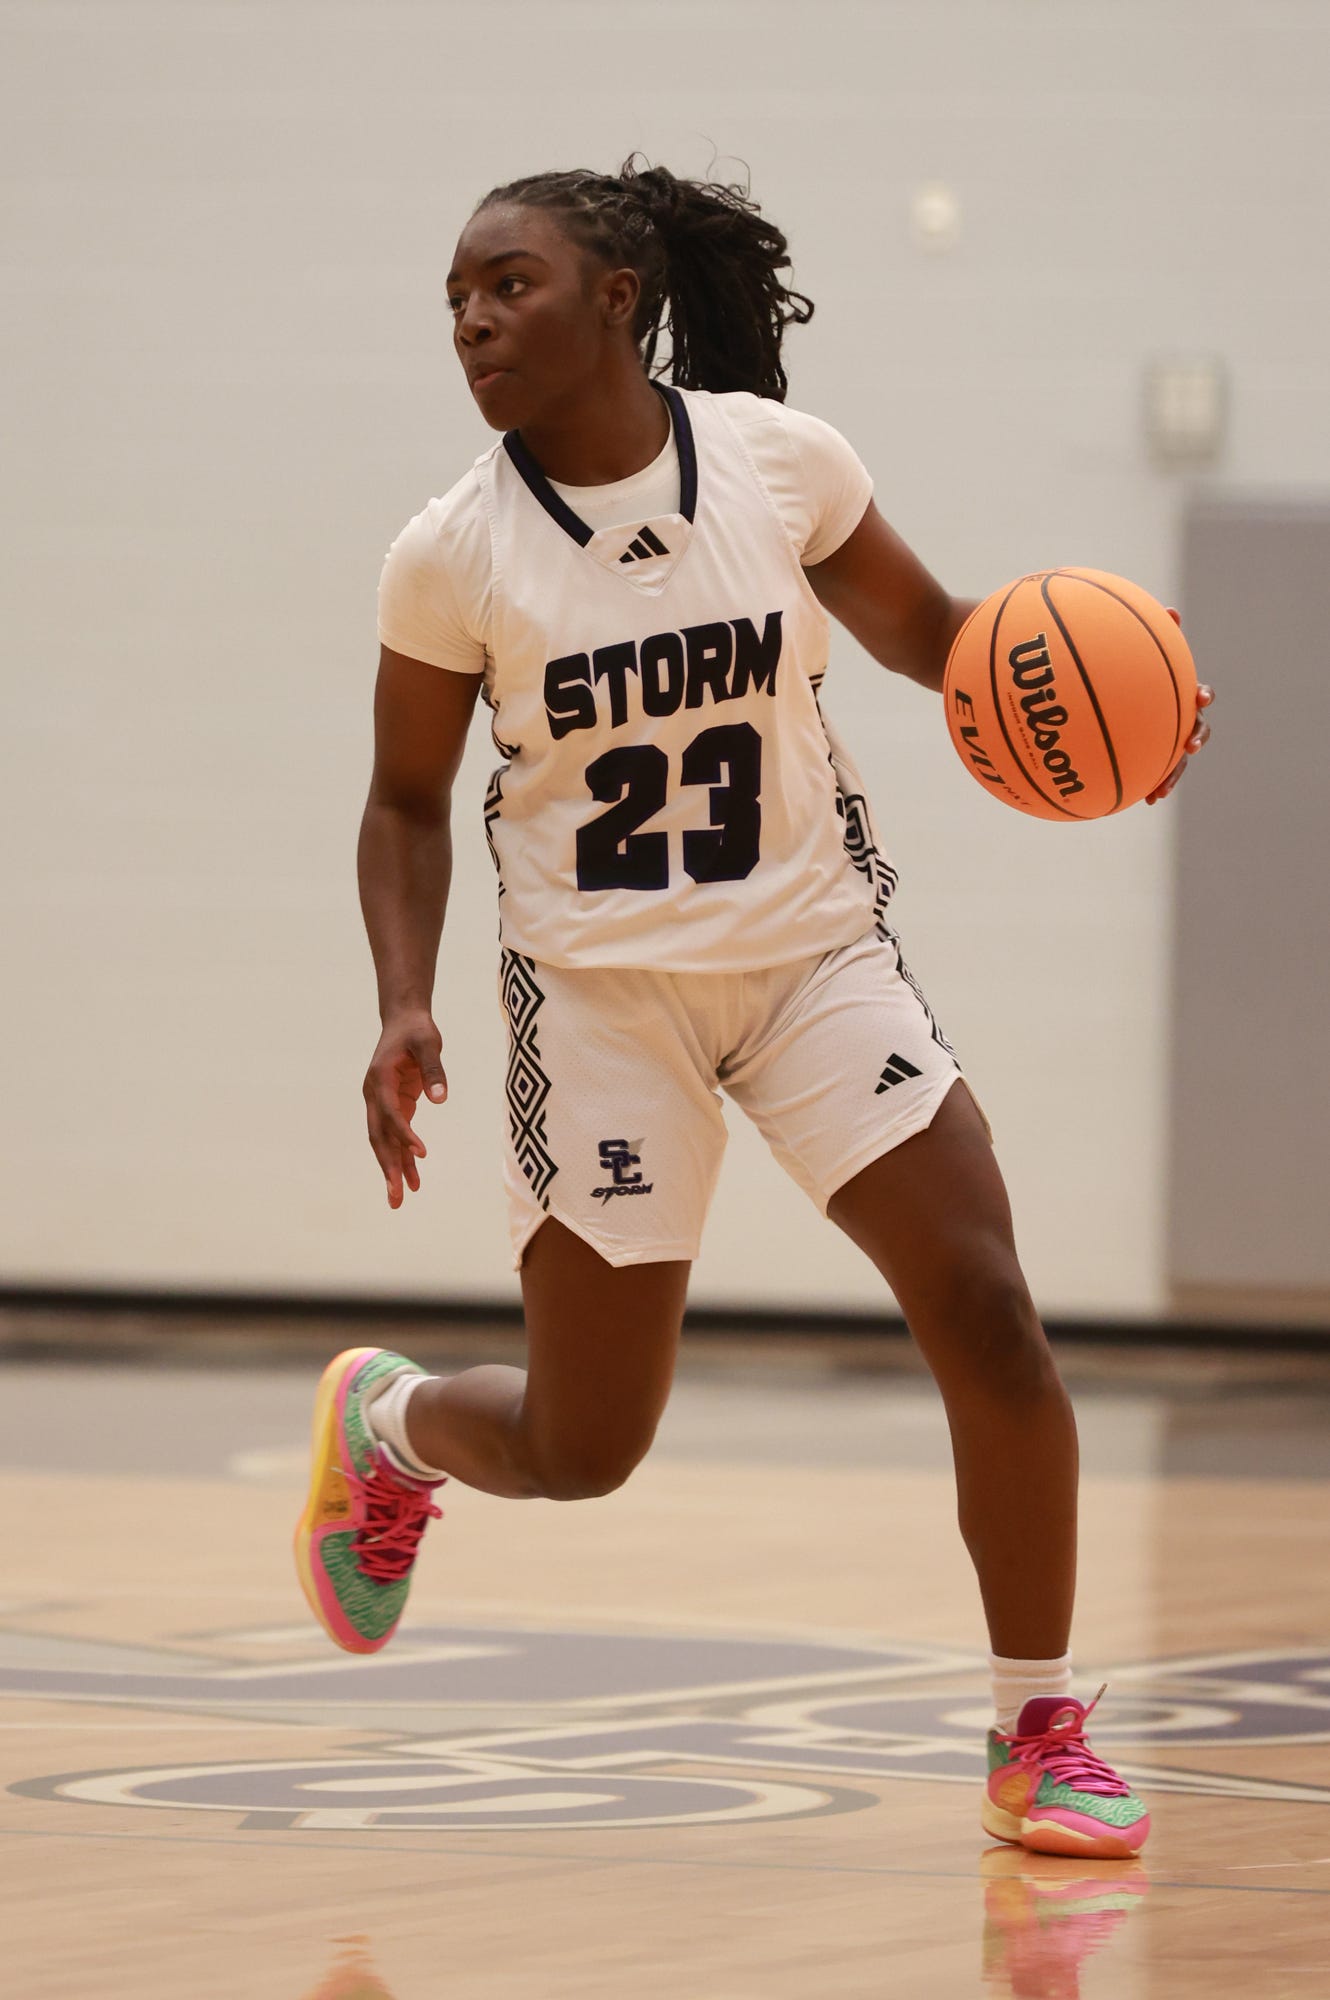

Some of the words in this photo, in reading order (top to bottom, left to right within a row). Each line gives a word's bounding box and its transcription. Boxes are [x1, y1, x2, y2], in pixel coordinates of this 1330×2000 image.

[544, 611, 783, 740] STORM
[1008, 632, 1085, 798] Wilson
[576, 722, 762, 891] 23
[590, 1183, 653, 1207] STORM
[598, 1139, 643, 1185] SC
